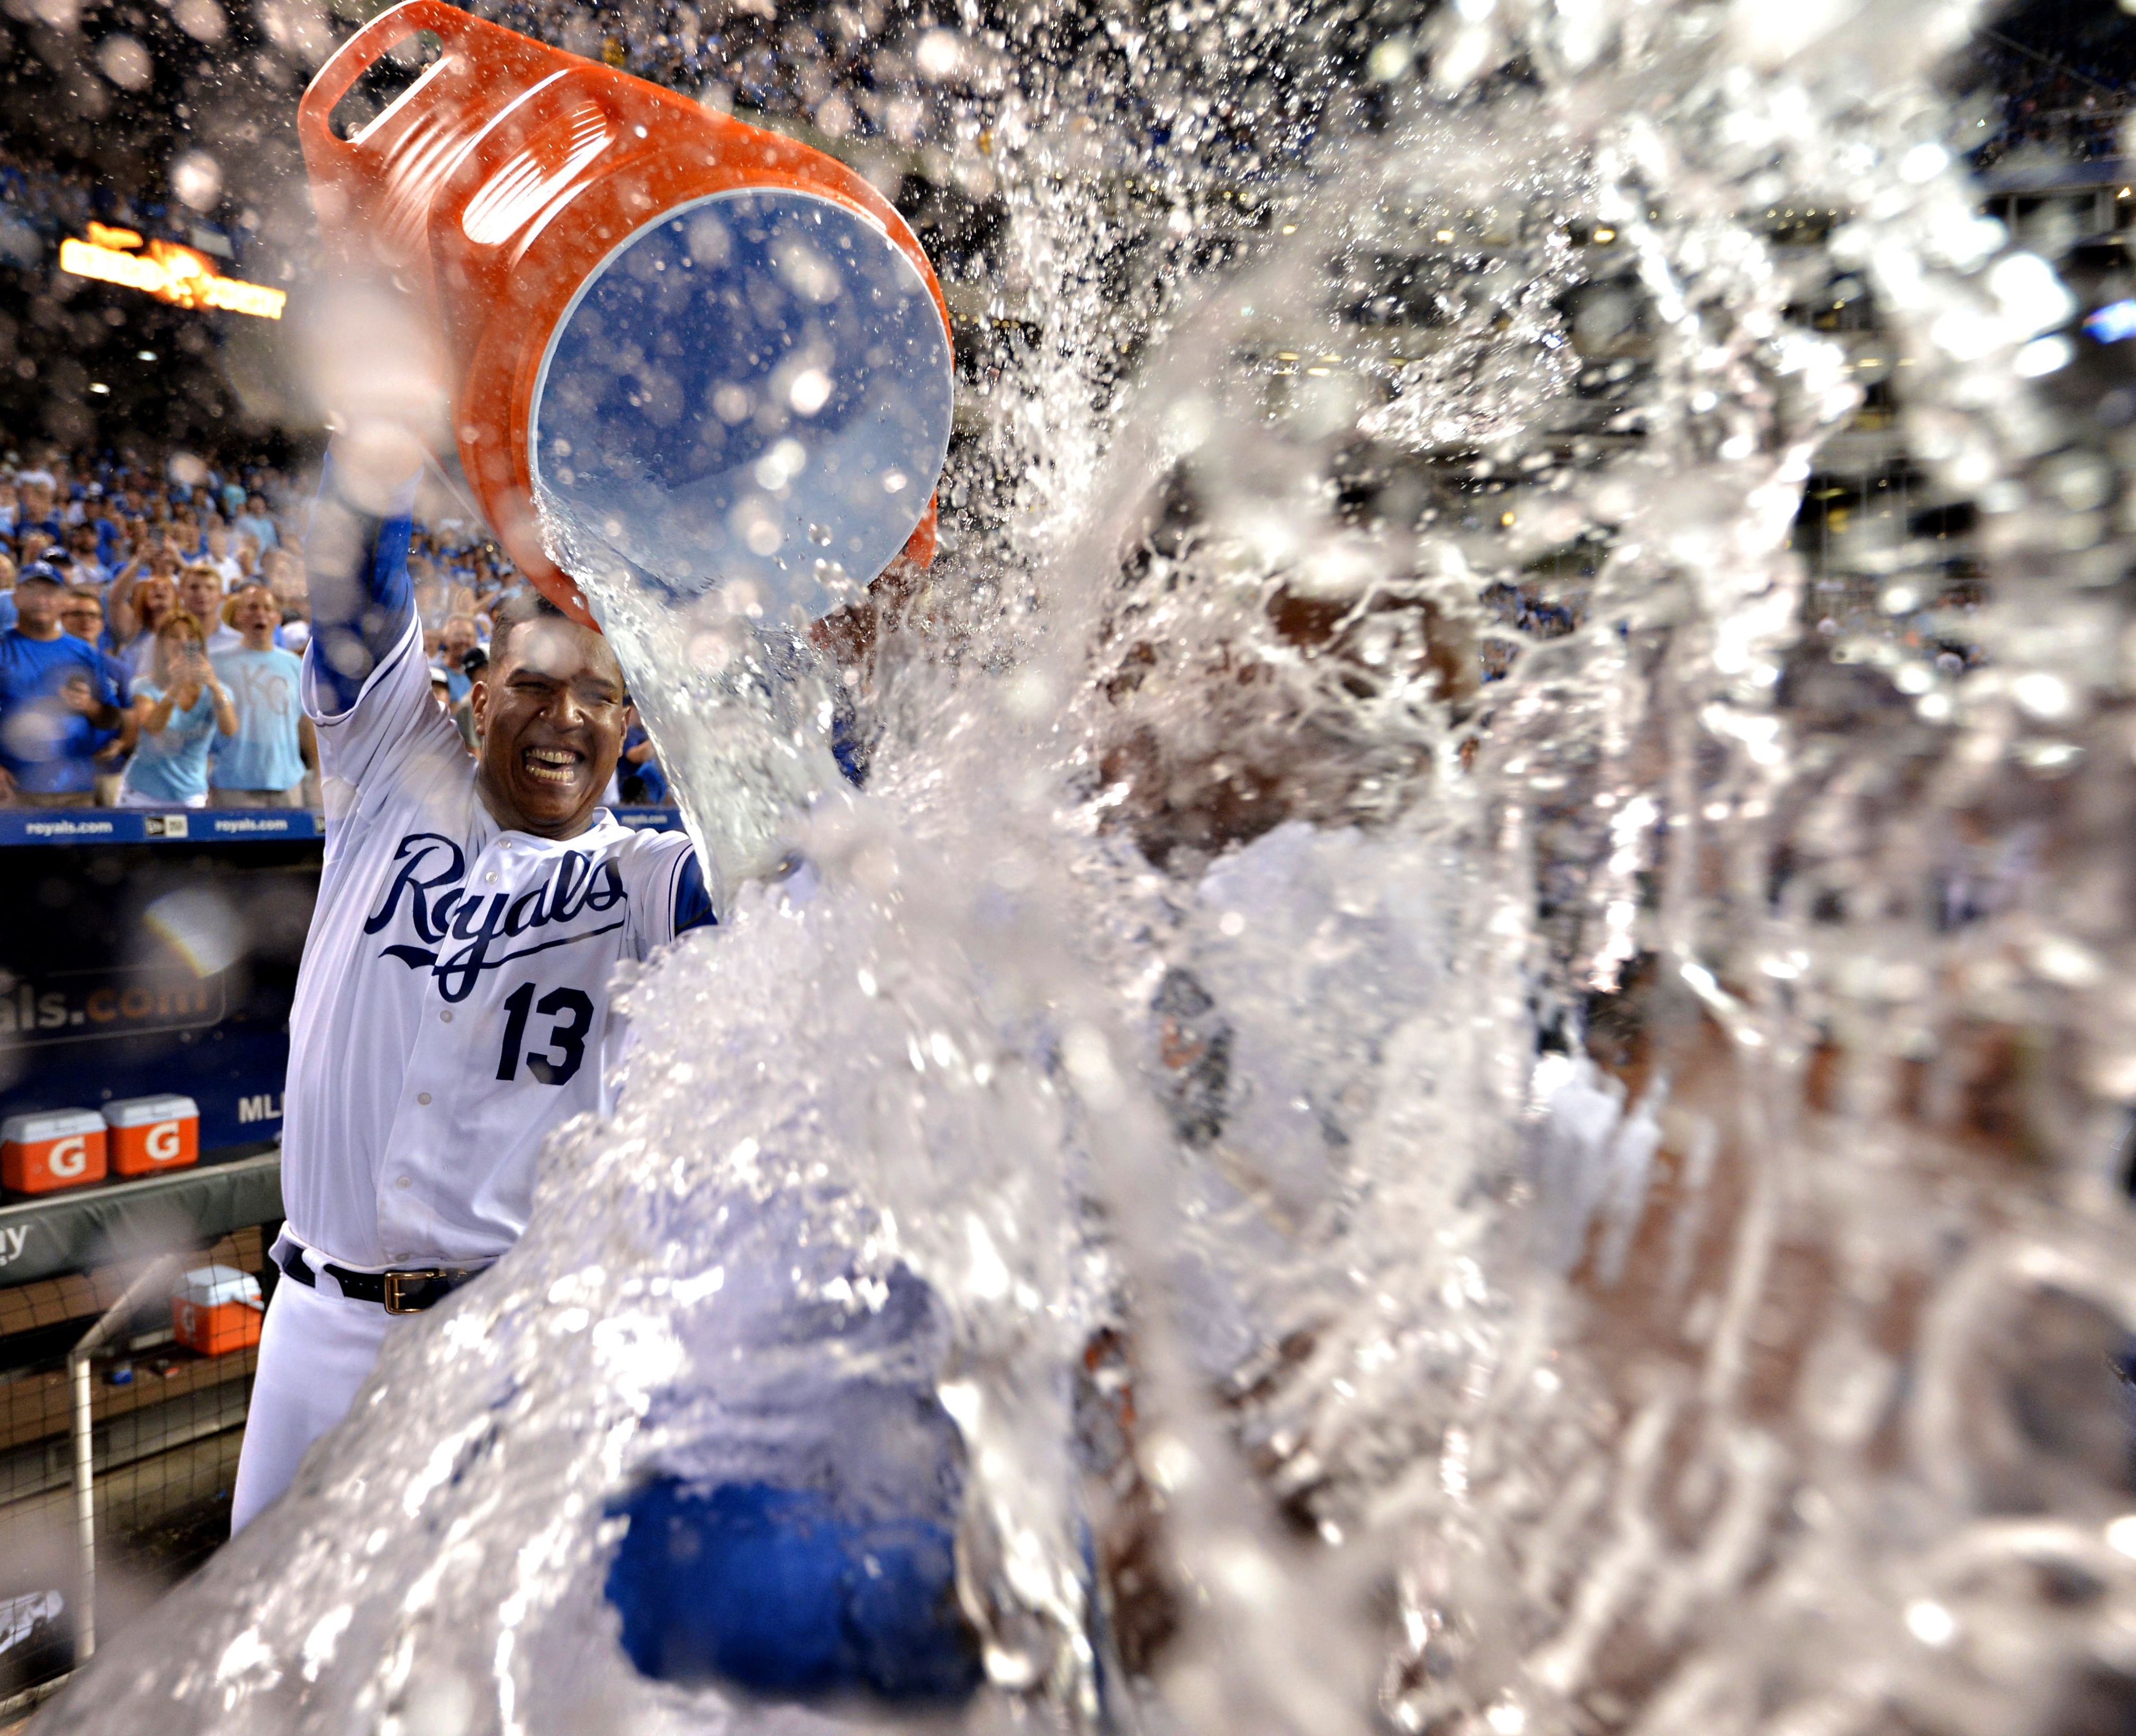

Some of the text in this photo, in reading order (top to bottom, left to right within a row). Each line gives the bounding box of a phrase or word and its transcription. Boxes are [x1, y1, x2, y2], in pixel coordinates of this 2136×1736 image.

[26, 819, 113, 837] royals.com
[215, 818, 287, 833] royals.com
[364, 833, 628, 1002] Royals
[495, 982, 594, 1086] 13
[49, 1136, 86, 1178] G
[146, 1122, 180, 1160] G
